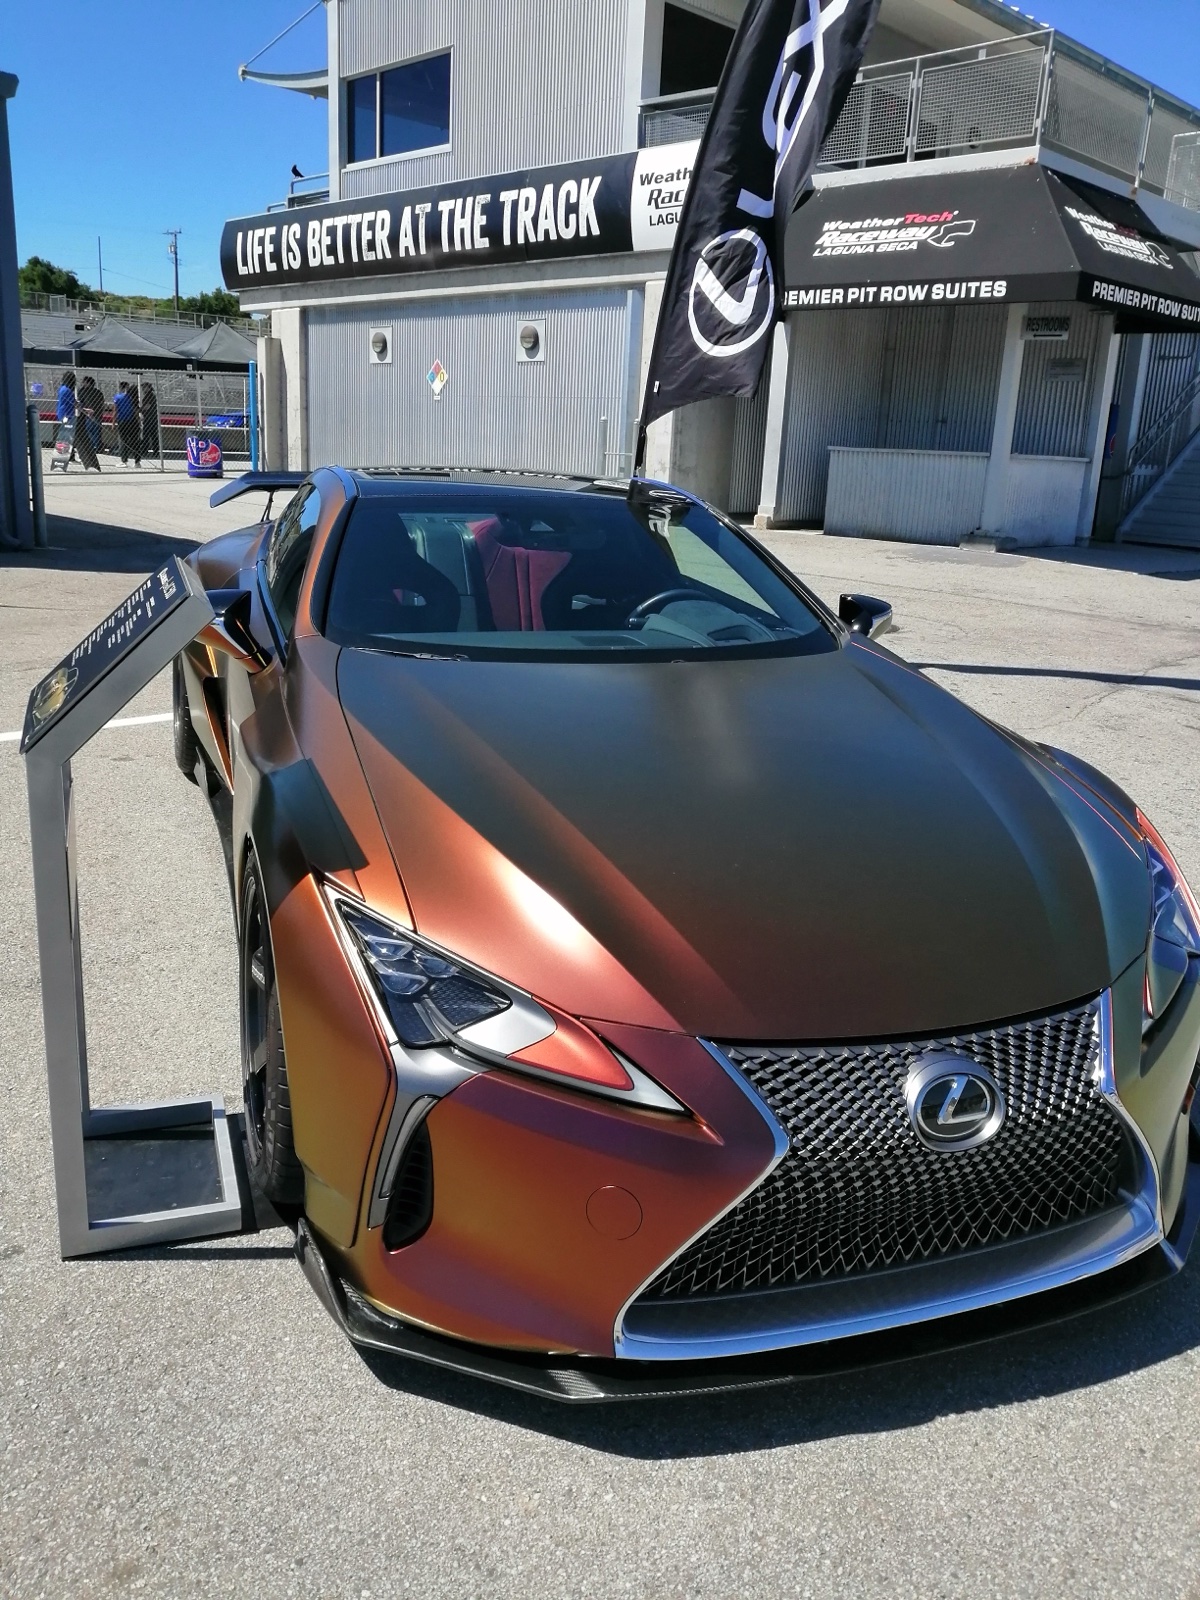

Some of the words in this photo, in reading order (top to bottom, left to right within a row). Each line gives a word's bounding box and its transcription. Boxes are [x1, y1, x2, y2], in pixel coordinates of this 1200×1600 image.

[236, 227, 278, 275] LIFE
[281, 222, 302, 271] IS
[306, 209, 392, 268] BETTER
[399, 203, 432, 257] AT
[438, 194, 491, 253] THE
[499, 176, 602, 246] TRACK
[815, 225, 938, 246] Raceway
[813, 242, 874, 257] LAGUNA
[876, 240, 918, 252] SECA
[847, 285, 878, 303] PIT
[880, 284, 928, 302] ROW
[931, 280, 1007, 299] SUITES
[1092, 280, 1141, 308] PREMIER
[1140, 293, 1158, 312] PIT
[1157, 299, 1182, 318] ROW
[1025, 316, 1070, 332] RESTROOMS
